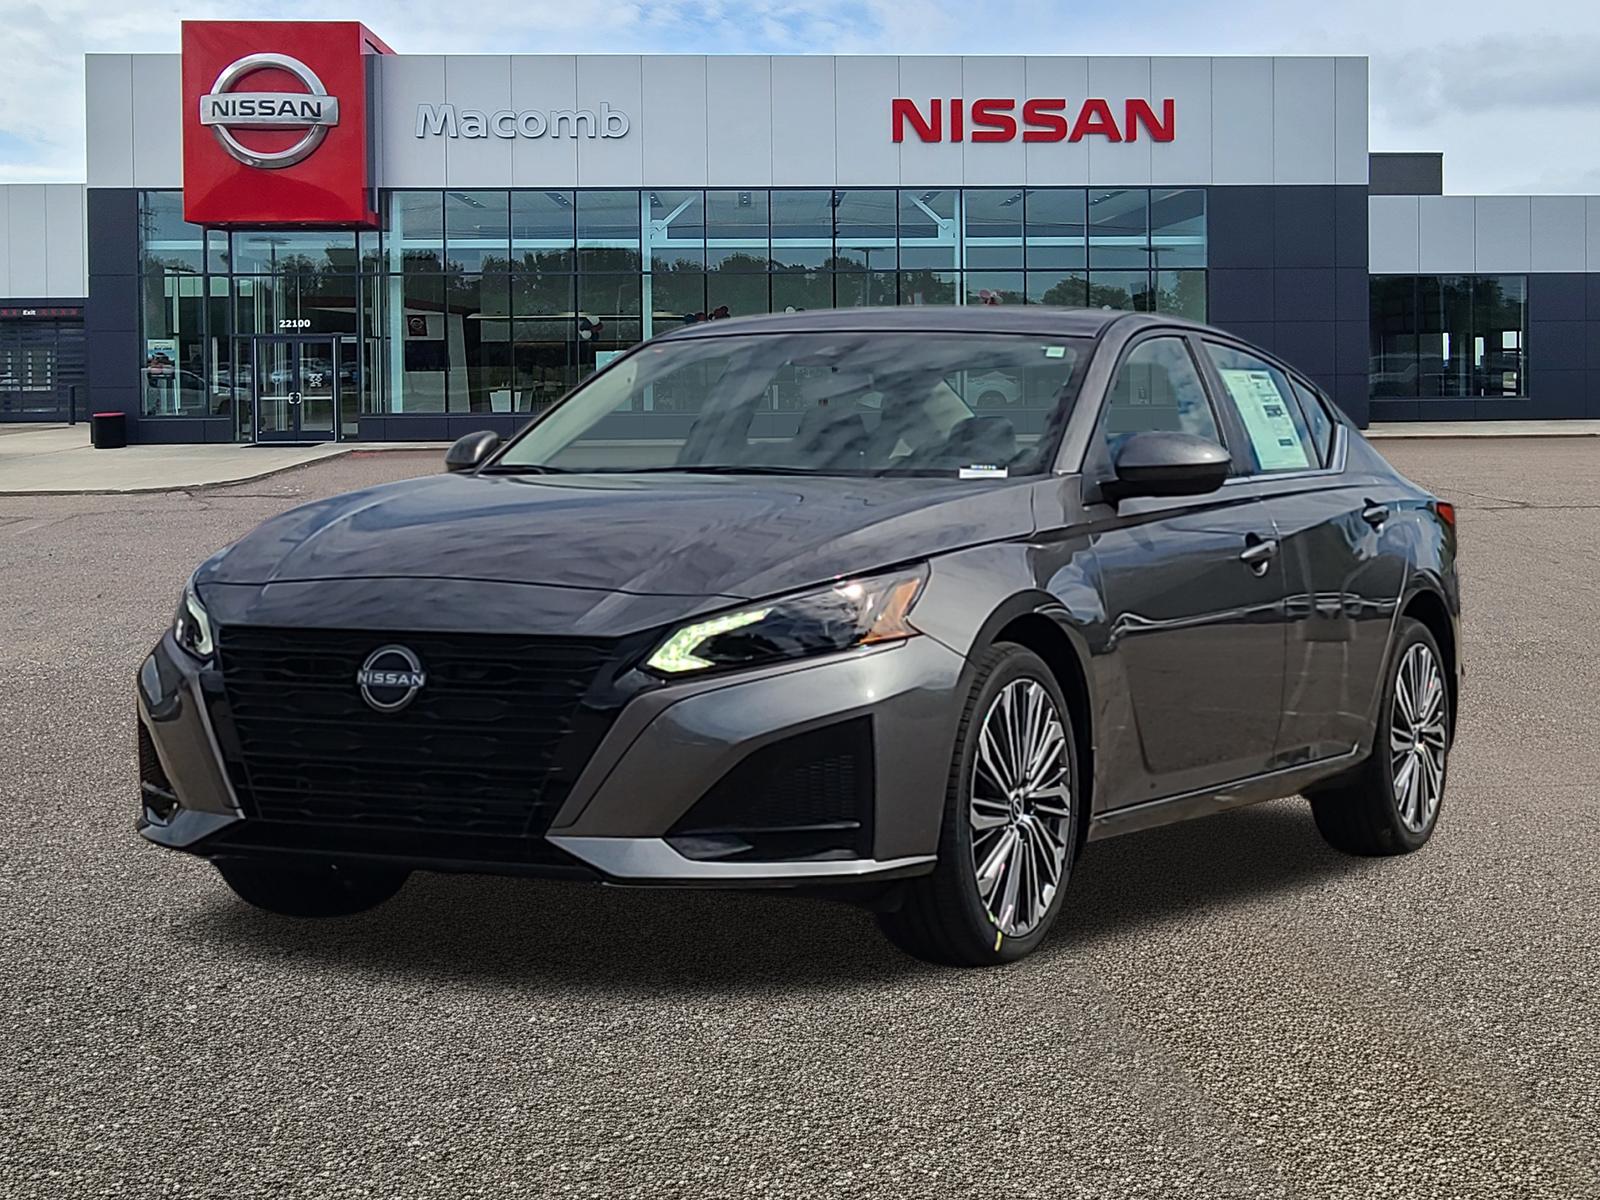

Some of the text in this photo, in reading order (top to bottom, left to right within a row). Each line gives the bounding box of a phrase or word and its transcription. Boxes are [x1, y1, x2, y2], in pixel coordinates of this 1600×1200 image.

[211, 99, 322, 118] NISSAN
[415, 101, 630, 139] Macomb
[892, 98, 1176, 143] NISSAN
[279, 319, 311, 328] 22100
[357, 670, 425, 686] NISSAN
